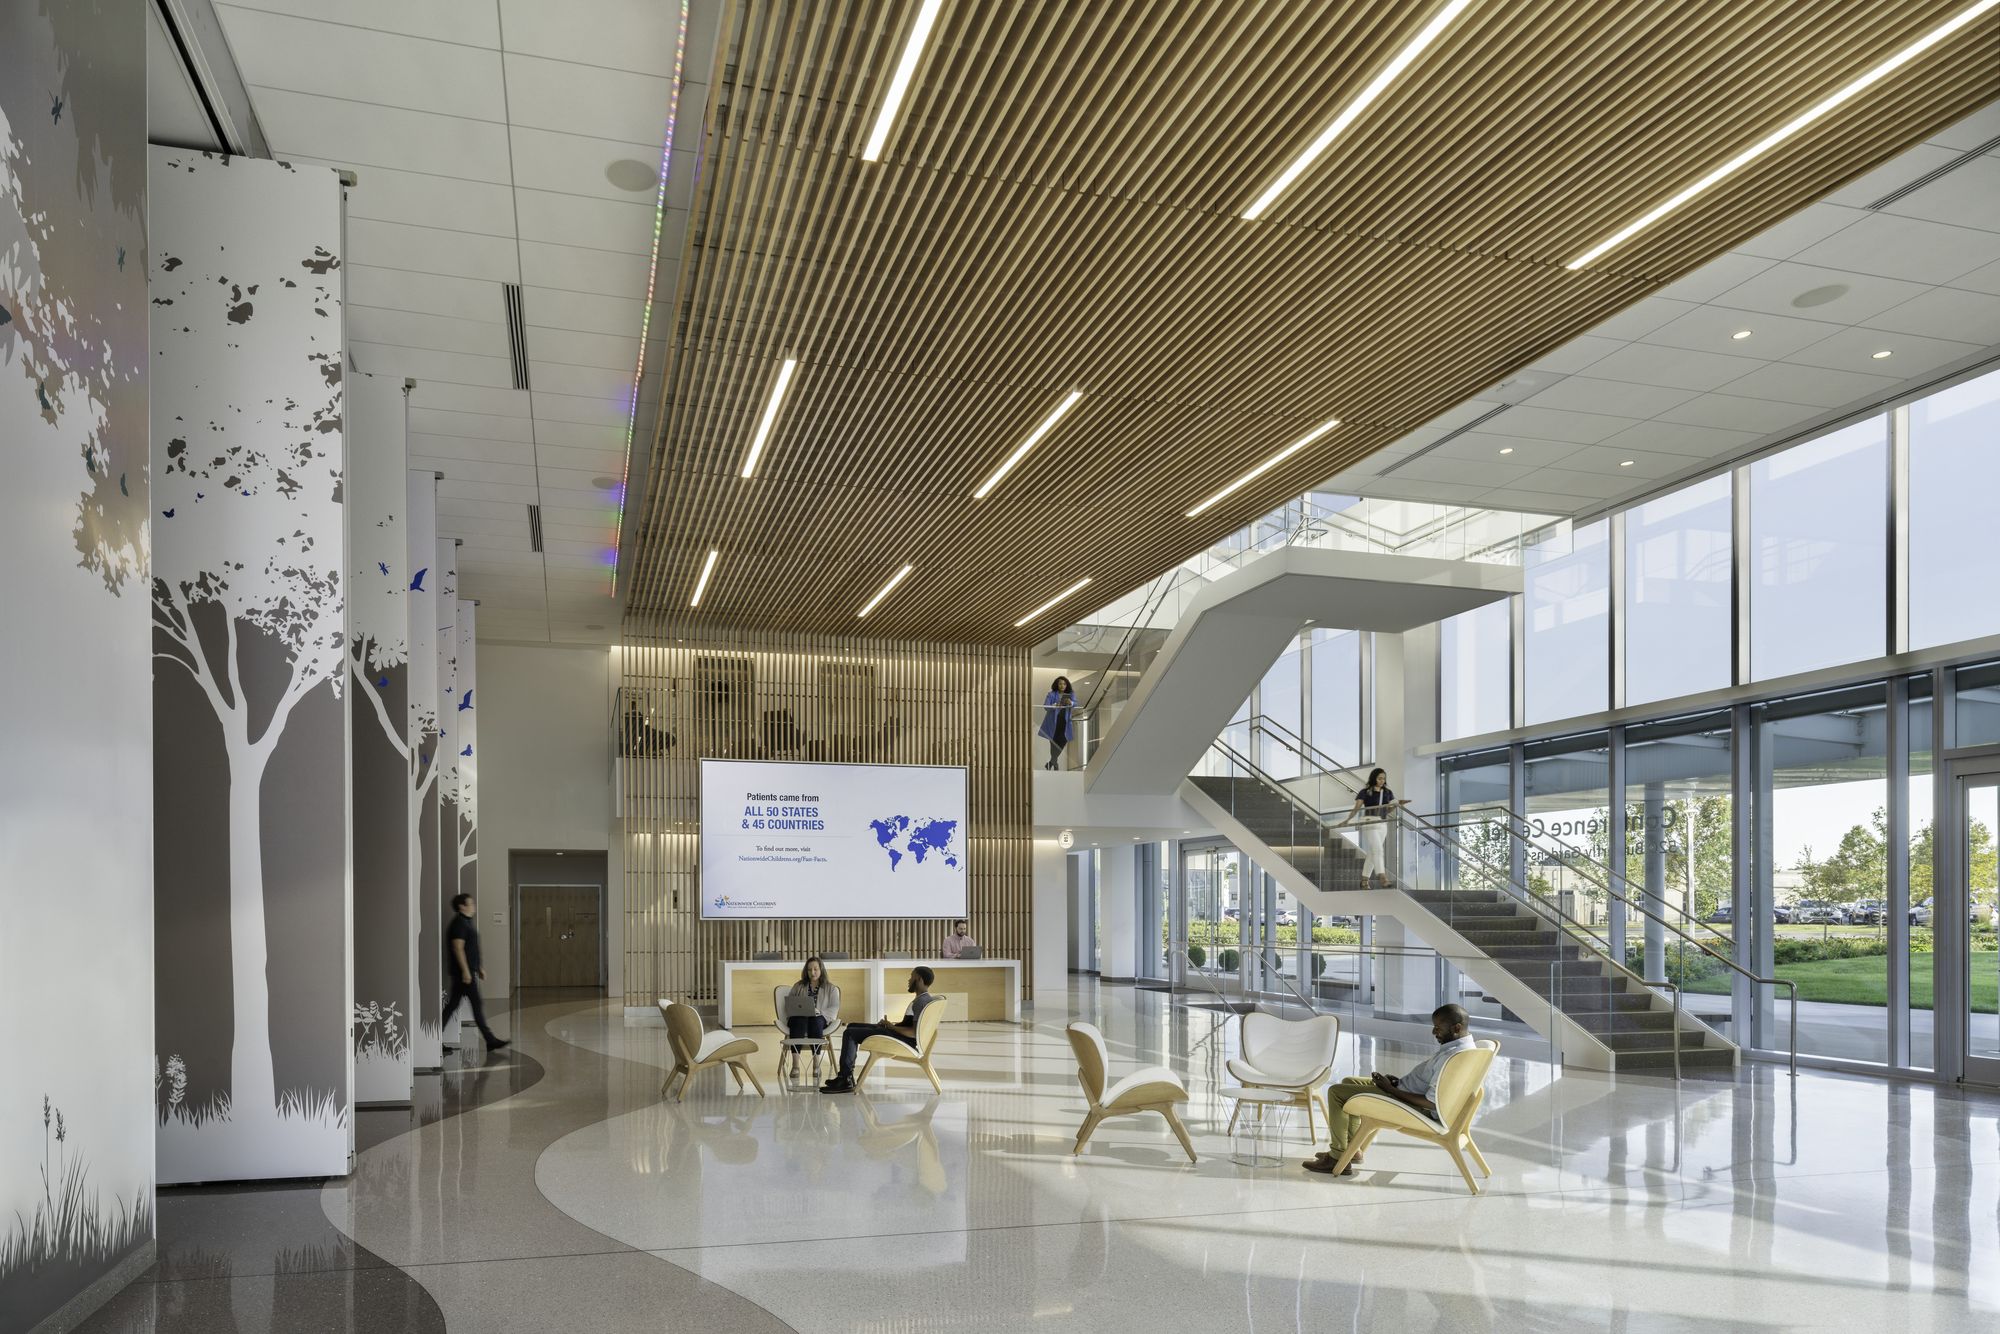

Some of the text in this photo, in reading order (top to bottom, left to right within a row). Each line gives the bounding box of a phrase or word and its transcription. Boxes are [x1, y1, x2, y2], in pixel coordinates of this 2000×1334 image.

[746, 792, 820, 803] Patients came from
[744, 806, 819, 818] ALL 50 STATES
[741, 818, 825, 831] & 45 COUNTRIES
